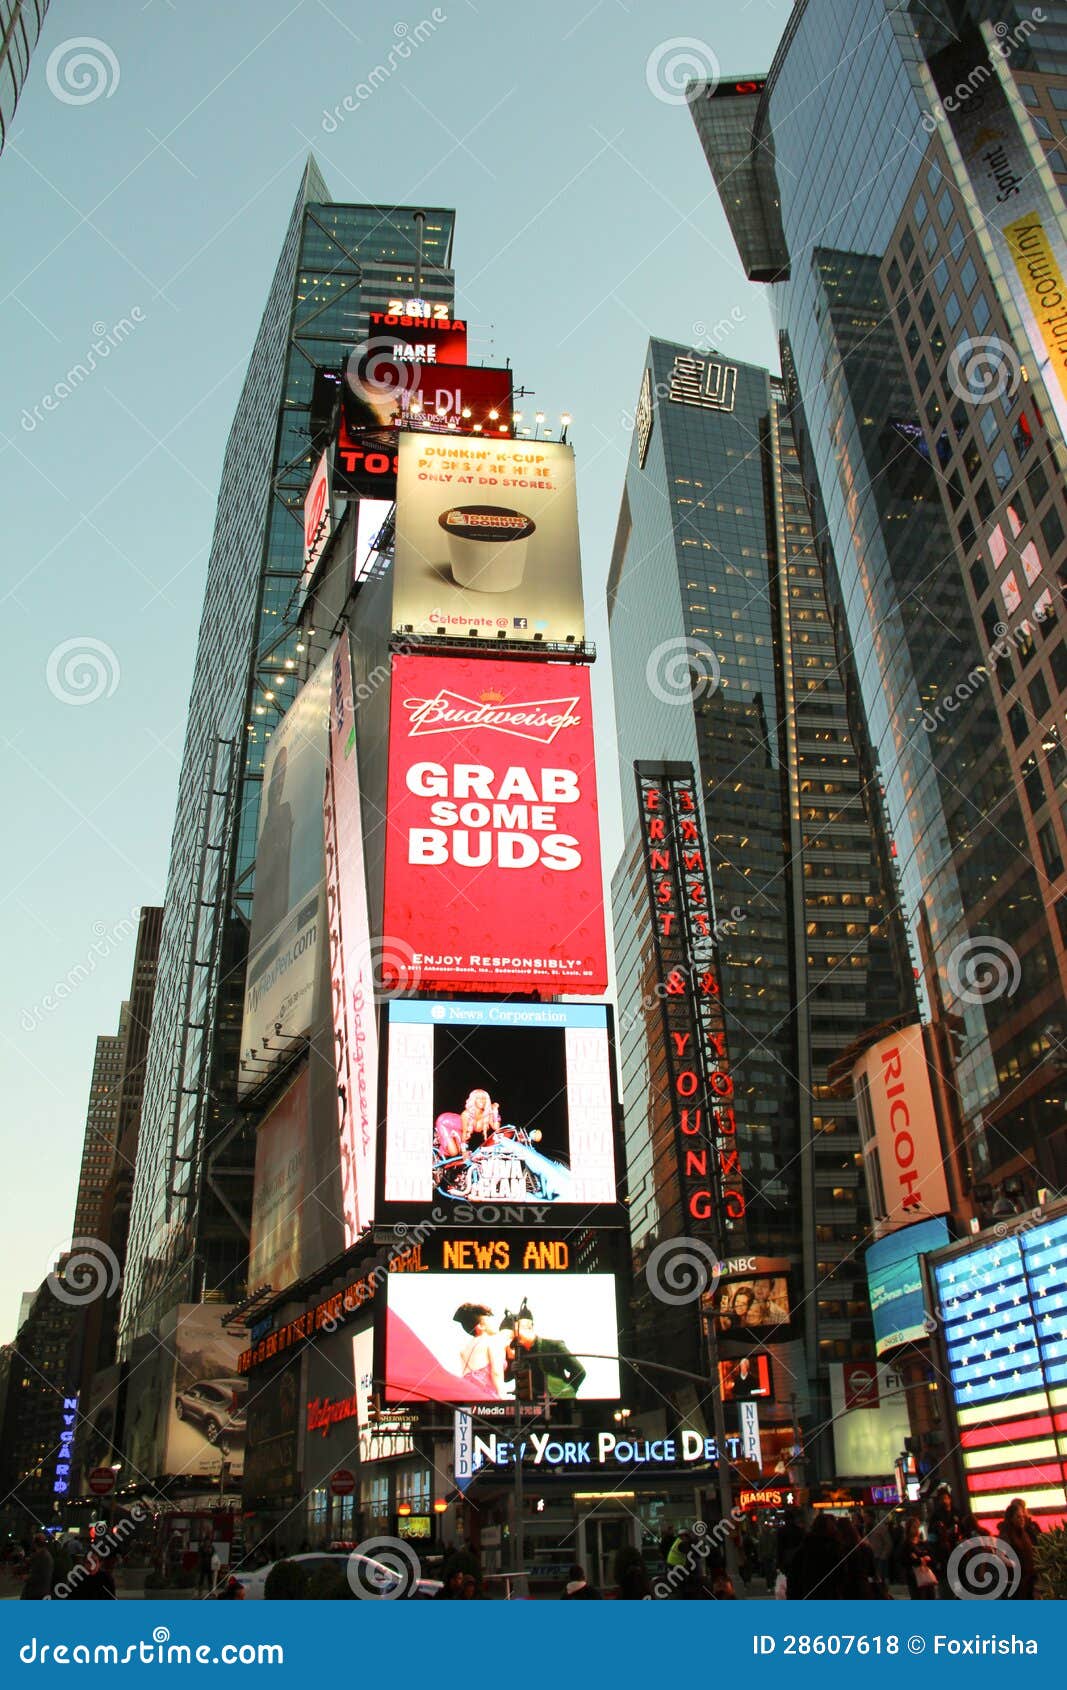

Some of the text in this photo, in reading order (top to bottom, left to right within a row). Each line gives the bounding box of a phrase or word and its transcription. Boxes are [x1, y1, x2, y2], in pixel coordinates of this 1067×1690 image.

[981, 145, 1022, 203] Sprint
[370, 312, 466, 332] TOSHIBA
[388, 300, 449, 320] 2012
[393, 344, 437, 358] HARE
[340, 452, 399, 474] TO
[425, 447, 490, 460] DUNKIN'
[418, 473, 557, 490] ONLY AT DD STORES.
[429, 614, 493, 626] Celebrate
[403, 698, 581, 728] Budweiser
[405, 761, 580, 803] GRAB
[430, 802, 557, 831] SOME
[408, 828, 582, 871] BUDS
[646, 788, 675, 937] ERNST
[412, 954, 462, 965] ENJOY
[449, 1007, 567, 1023] News Corporation
[672, 1029, 713, 1221] YOUNG
[881, 1047, 922, 1209] RICOH
[453, 1205, 551, 1224] SONY
[442, 1240, 510, 1270] NEWS
[522, 1241, 569, 1270] AND
[728, 1258, 757, 1274] NBC
[459, 1411, 468, 1475] NYPD
[530, 1432, 591, 1464] YORK
[599, 1432, 675, 1463] POLICE
[681, 1429, 740, 1460] DET
